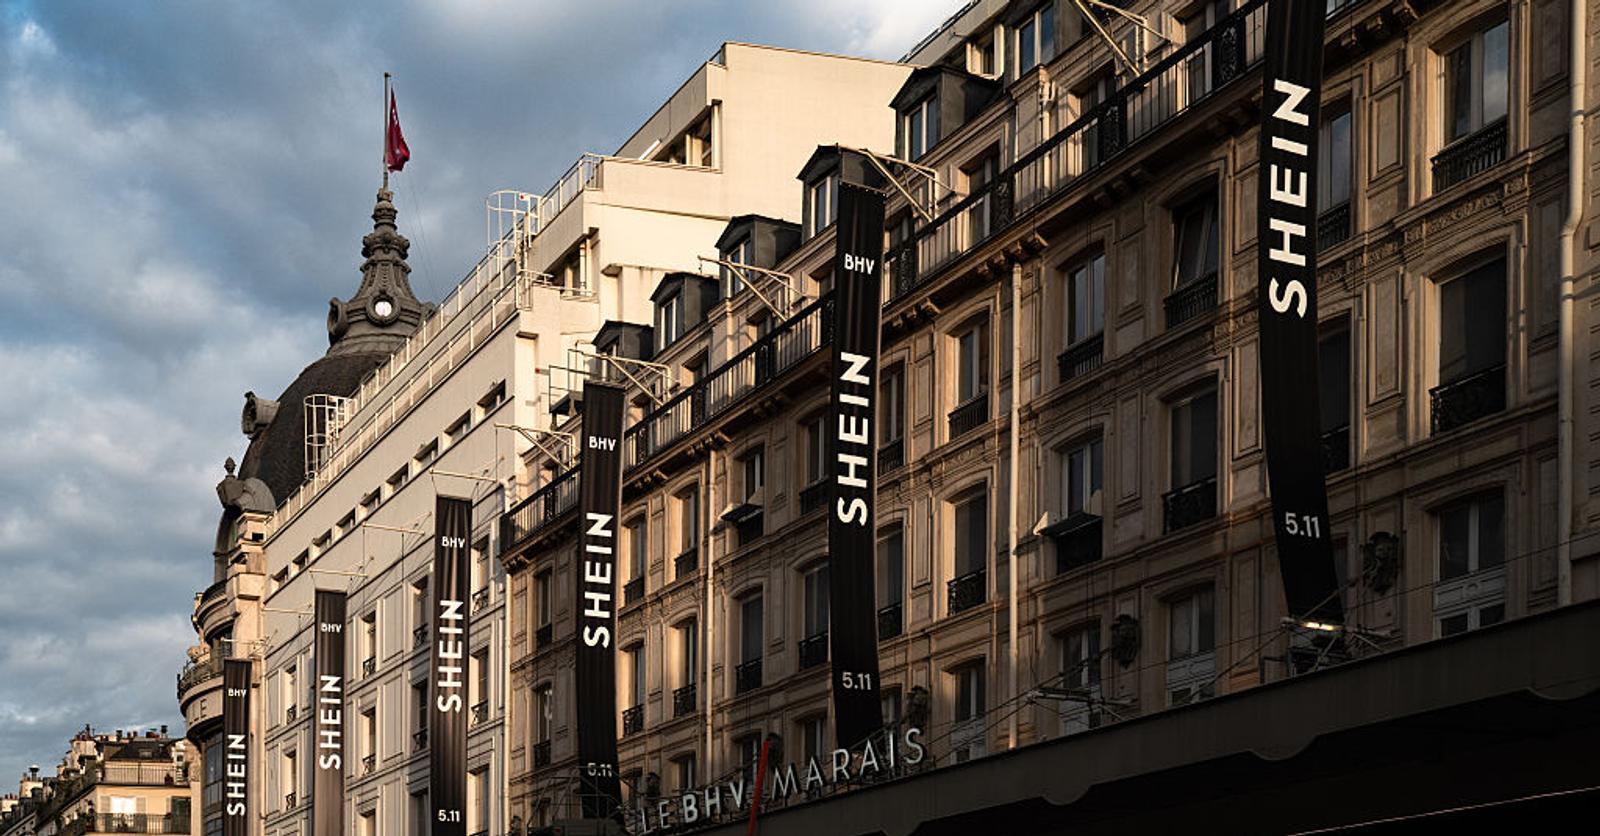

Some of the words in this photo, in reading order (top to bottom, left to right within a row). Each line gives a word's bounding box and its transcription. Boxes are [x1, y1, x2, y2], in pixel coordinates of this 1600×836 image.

[1268, 77, 1312, 319] SHEIN
[843, 252, 876, 276] BHV
[588, 435, 617, 452] BHV
[837, 350, 872, 527] SHEIN
[1284, 511, 1321, 539] 5.11
[441, 535, 466, 549] BHV
[583, 511, 614, 649] SHEIN
[320, 621, 342, 633] BHV
[437, 599, 464, 714] SHEIN
[227, 687, 247, 698] BHV
[841, 670, 872, 691] 5.11
[319, 674, 342, 770] SHEIN
[226, 734, 246, 817] SHEIN
[587, 762, 613, 778] 5.11
[641, 800, 672, 834] LE
[681, 779, 745, 824] BHV
[770, 727, 925, 801] MARAIS
[437, 808, 461, 823] 5.11
